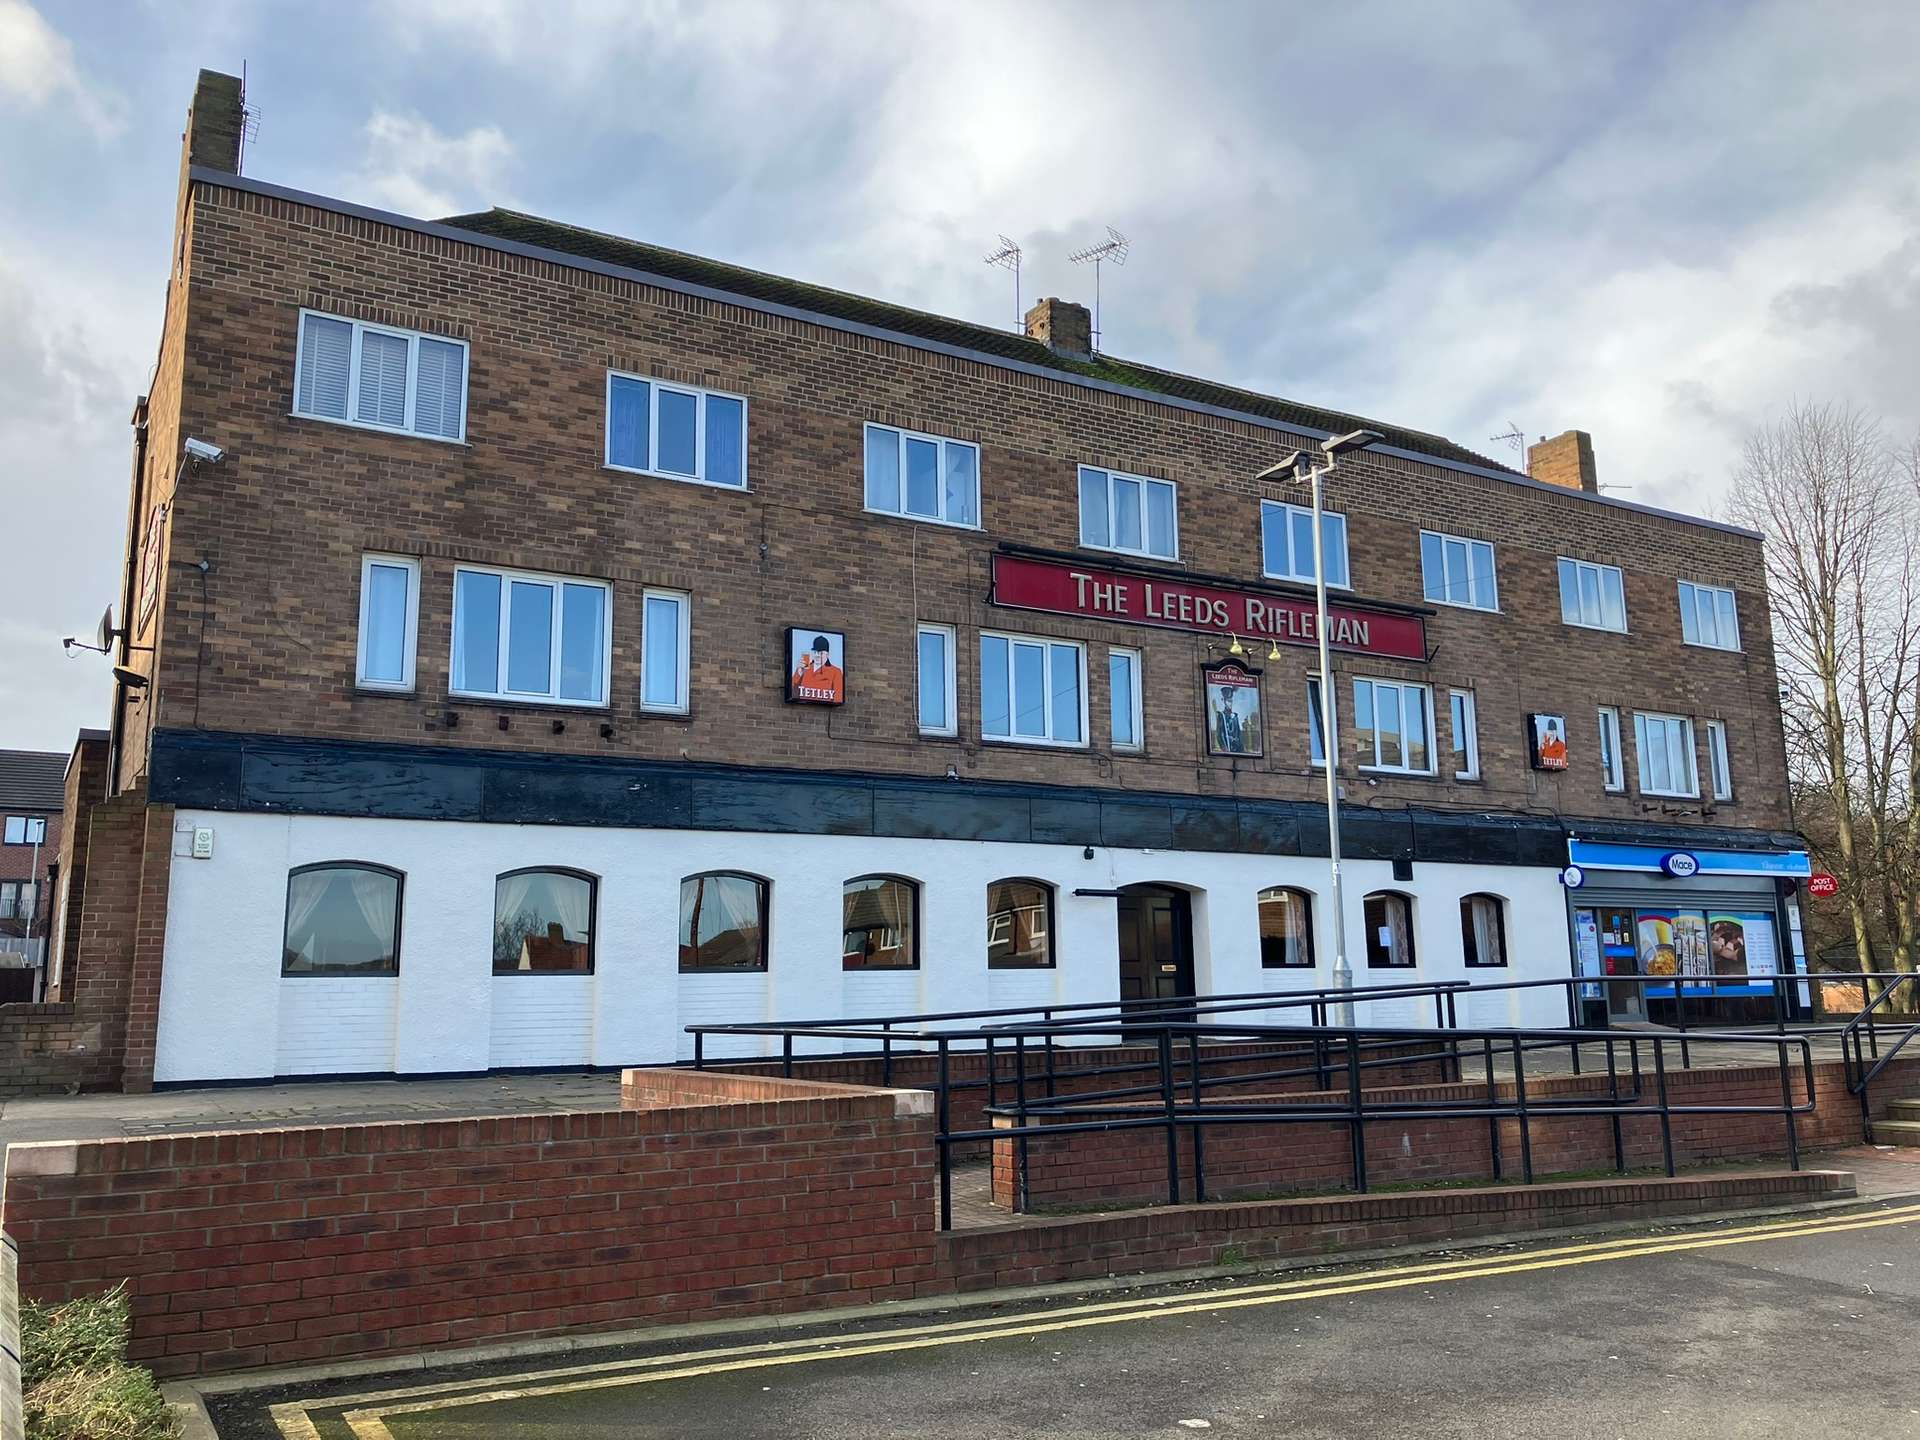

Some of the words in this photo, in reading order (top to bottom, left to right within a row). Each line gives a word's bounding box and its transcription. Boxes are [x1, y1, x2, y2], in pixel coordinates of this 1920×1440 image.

[1070, 572, 1128, 613] THE
[1145, 583, 1230, 627] LEEDS
[1245, 598, 1369, 645] RIFLEMAN
[798, 686, 835, 699] TETLEY
[1671, 859, 1693, 870] Mace
[1813, 877, 1831, 885] POST
